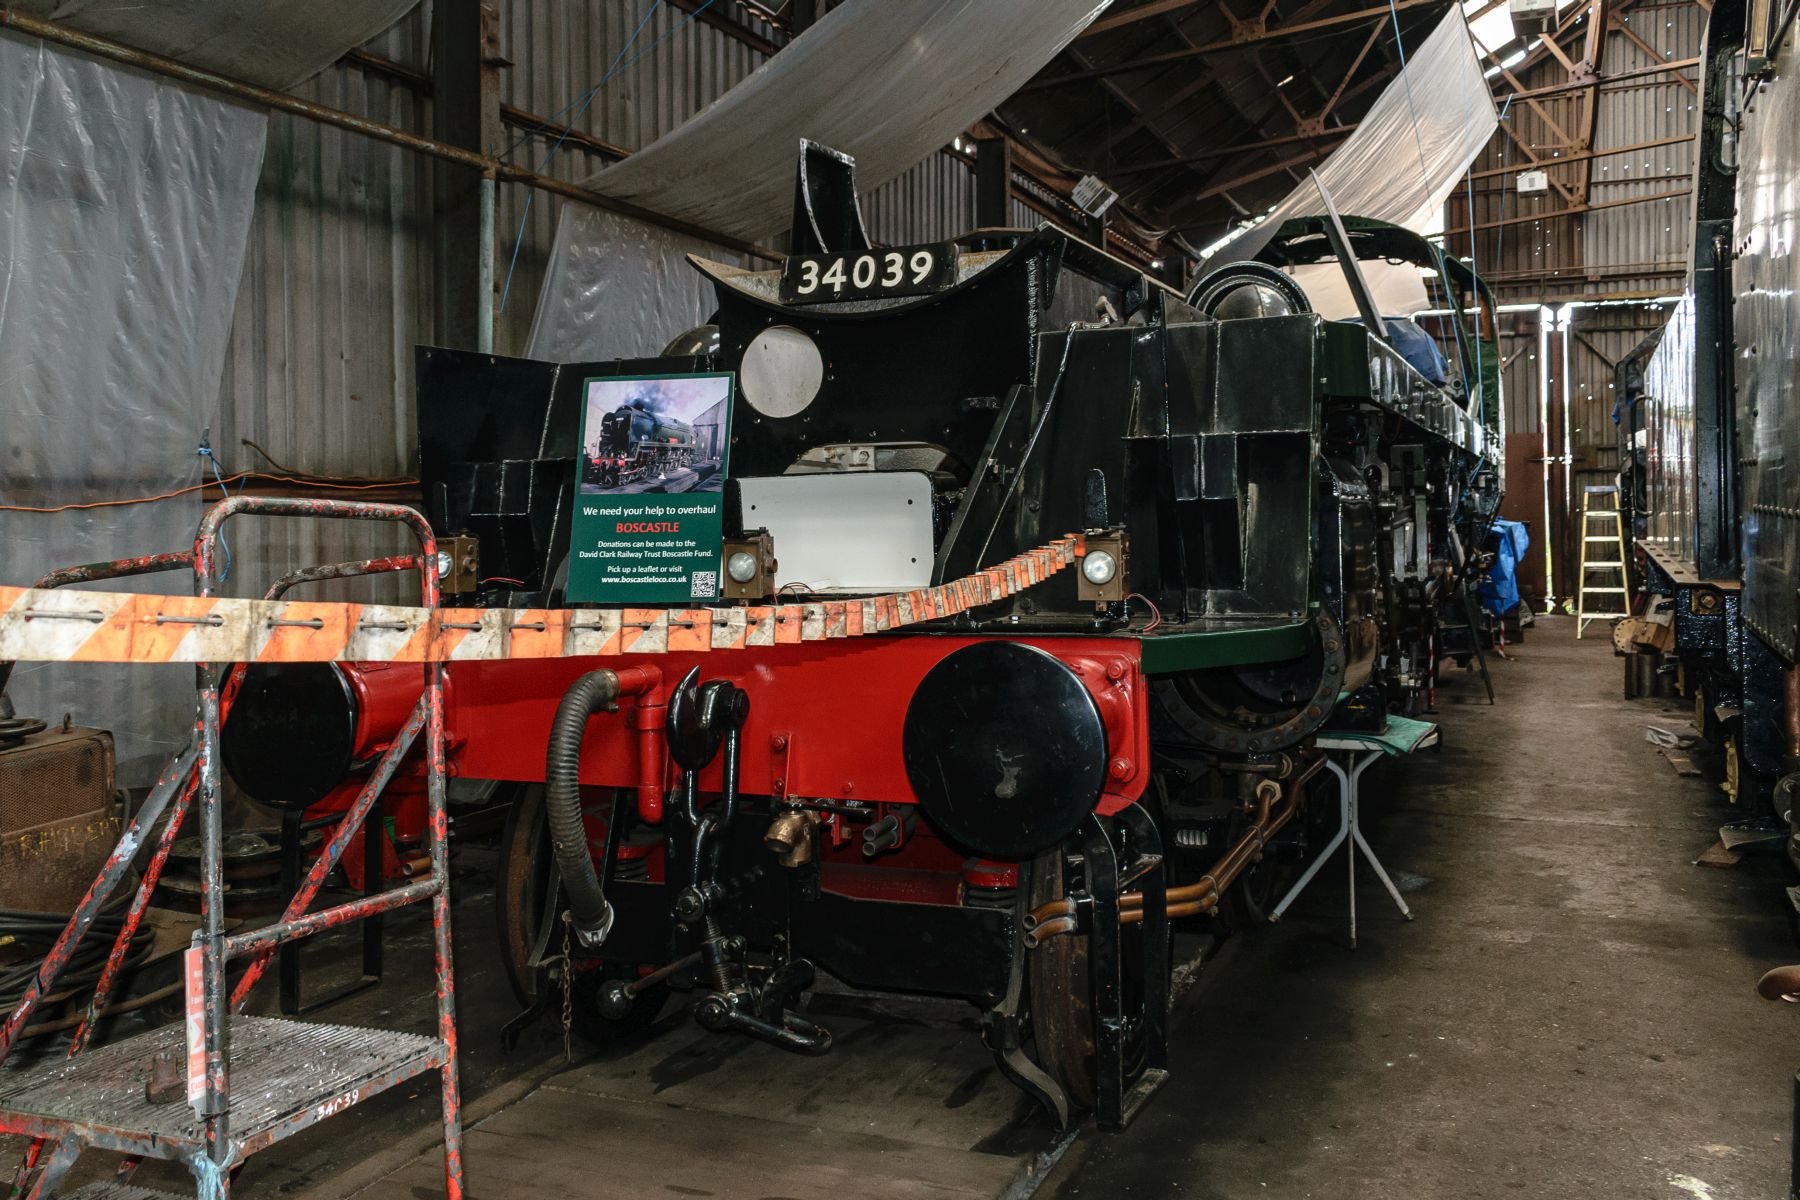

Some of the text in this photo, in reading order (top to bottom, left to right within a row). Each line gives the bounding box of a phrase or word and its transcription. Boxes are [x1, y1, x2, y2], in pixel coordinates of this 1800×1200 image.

[797, 251, 934, 295] 34039
[583, 505, 716, 517] We need your help to overhaul
[615, 522, 680, 533] BOSCASTLE
[598, 540, 631, 548] Donations
[645, 540, 655, 548] be
[684, 539, 696, 547] the
[599, 550, 616, 558] Clark
[617, 550, 643, 559] Railway
[643, 550, 661, 558] Trust
[662, 550, 693, 558] Boscastle
[607, 565, 621, 573] Pick
[622, 566, 631, 574] up
[637, 565, 659, 573] leaflet
[668, 565, 683, 573] visit
[601, 575, 687, 584] www.boscastleloco.co.uk
